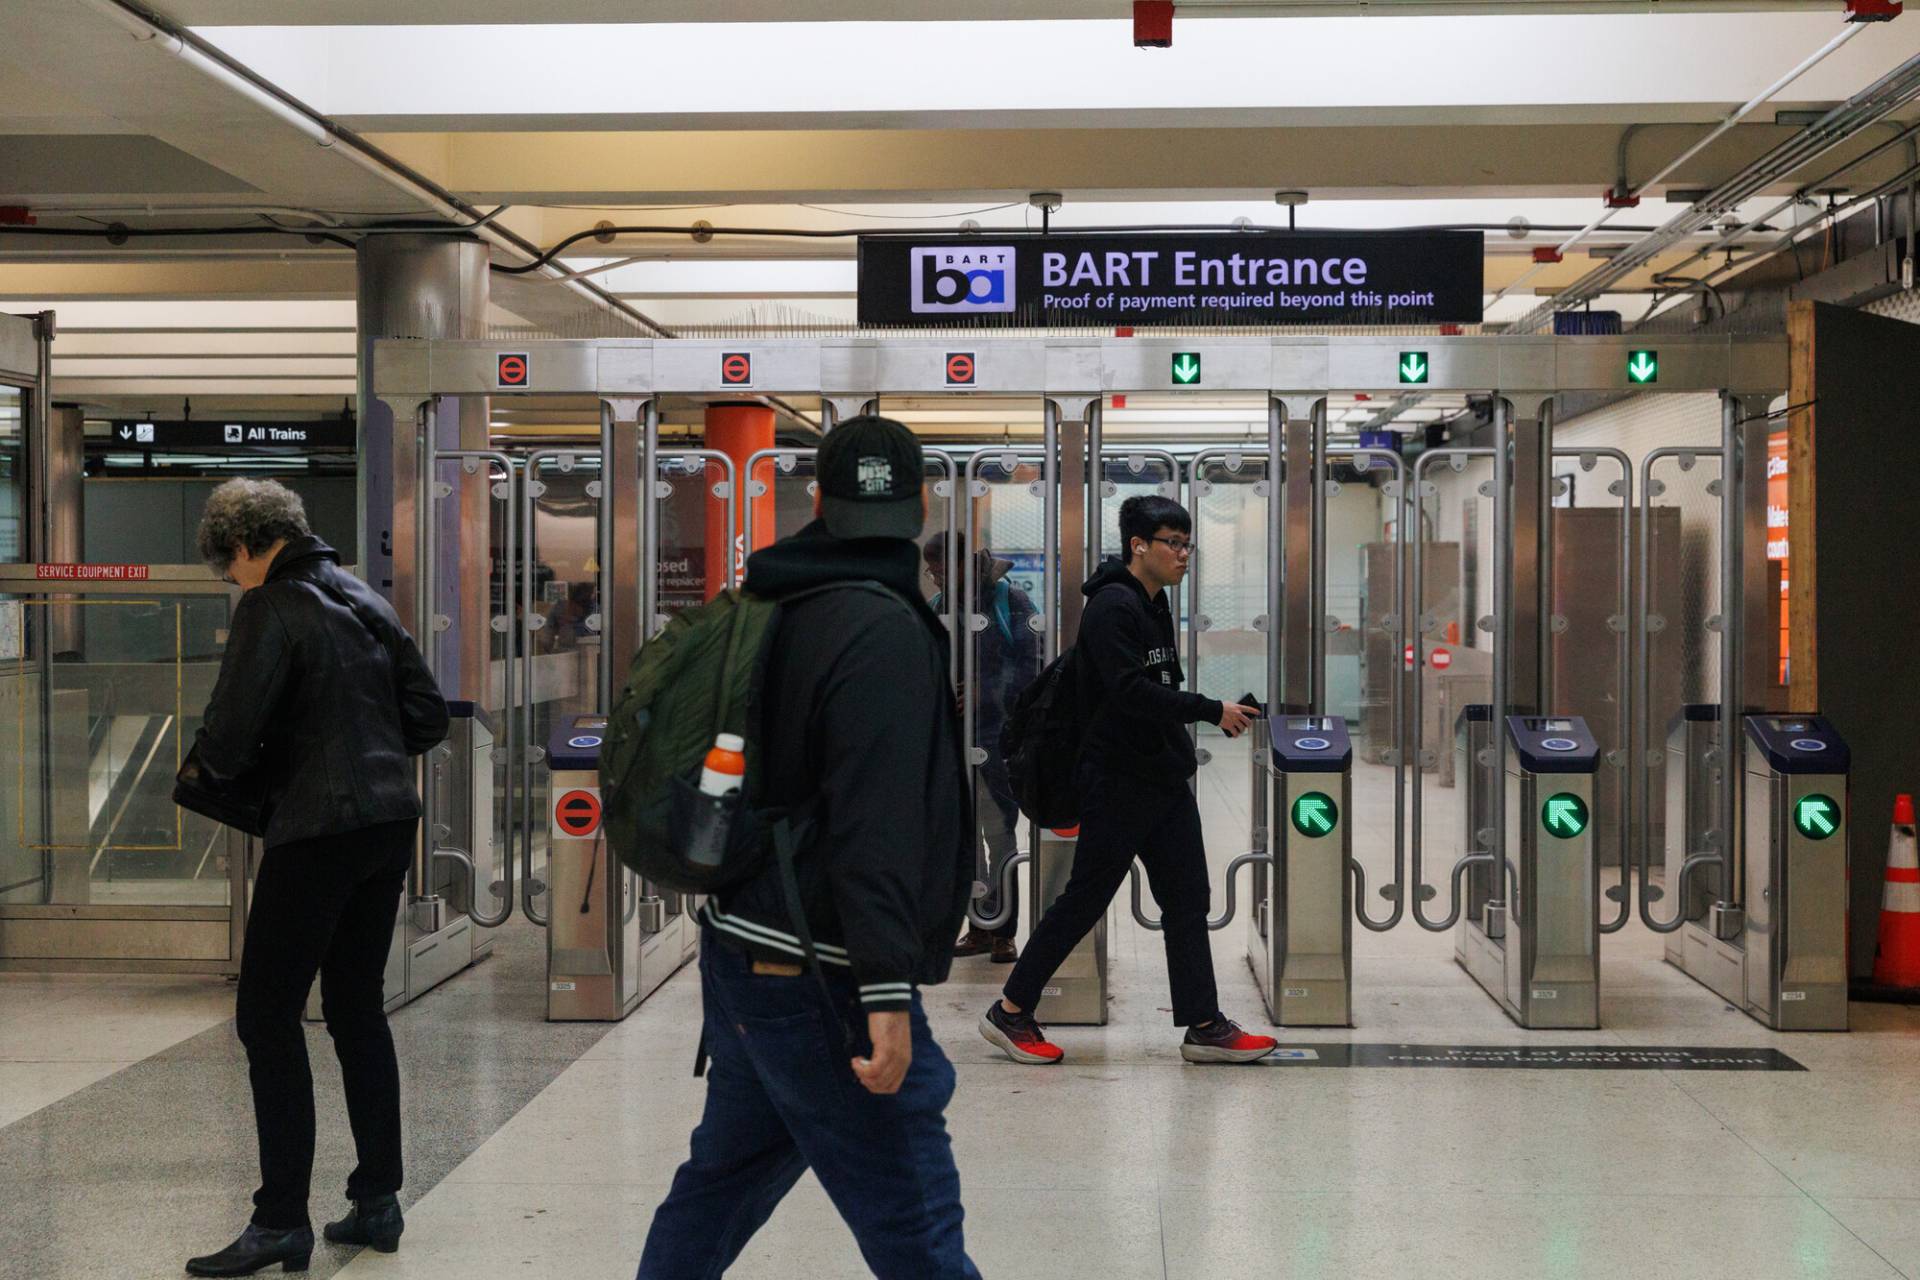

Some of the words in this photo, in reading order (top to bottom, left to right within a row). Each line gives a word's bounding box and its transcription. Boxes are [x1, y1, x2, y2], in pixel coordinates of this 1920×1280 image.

[945, 254, 1006, 264] BART
[1042, 252, 1158, 287] BART
[1174, 251, 1367, 287] Entrance
[1043, 293, 1091, 309] Proof
[1095, 293, 1114, 309] of
[1119, 294, 1196, 312] payment
[1201, 291, 1274, 311] required
[1280, 291, 1344, 311] beyond
[1350, 291, 1382, 306] this
[1388, 291, 1434, 309] point
[247, 427, 266, 441] All
[269, 427, 307, 441] Trains
[38, 565, 74, 578] SERVICE
[77, 565, 125, 578] EQUIPMENT
[127, 565, 147, 578] EXIT
